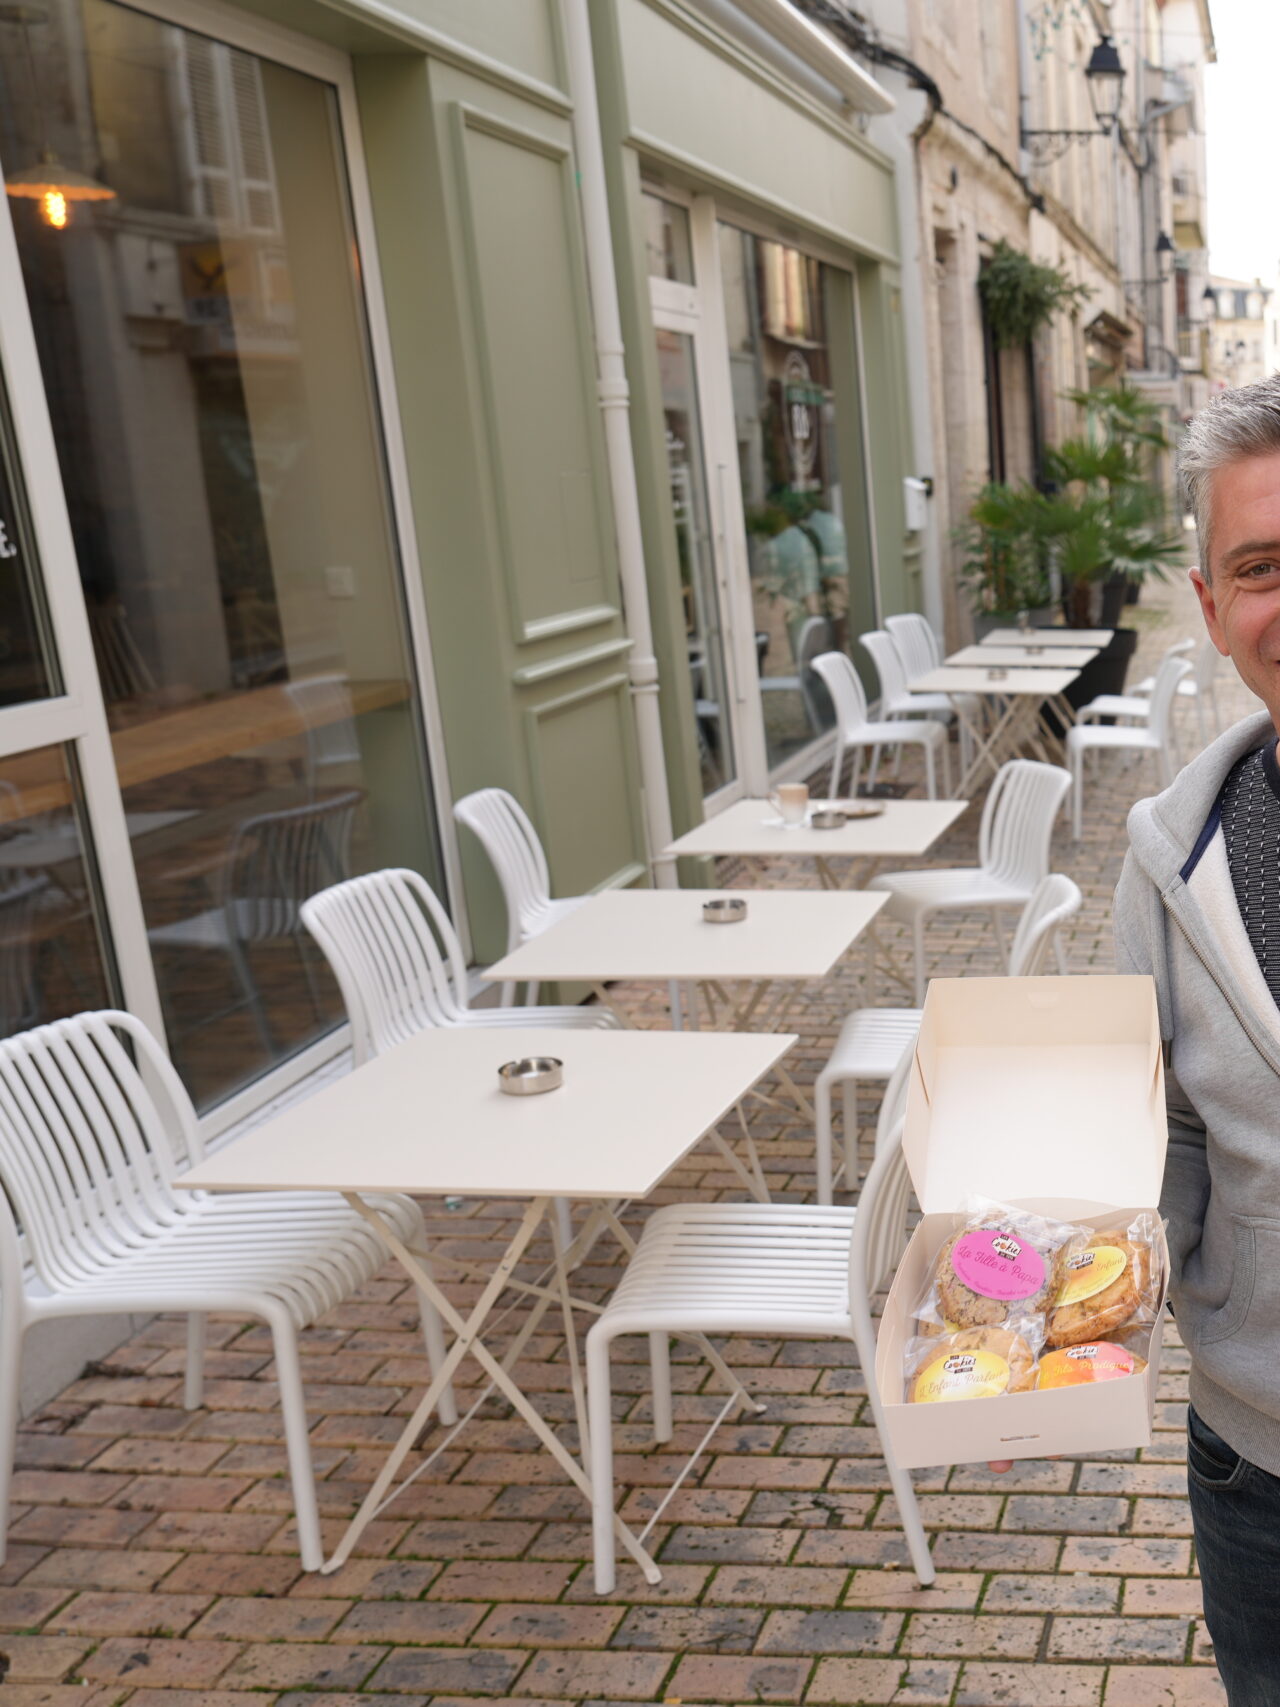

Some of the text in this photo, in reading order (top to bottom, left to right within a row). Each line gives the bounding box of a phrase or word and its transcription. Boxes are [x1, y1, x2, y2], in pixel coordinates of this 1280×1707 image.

[958, 1245, 971, 1260] La
[974, 1251, 998, 1270] Fille
[1010, 1263, 1041, 1285] Papa
